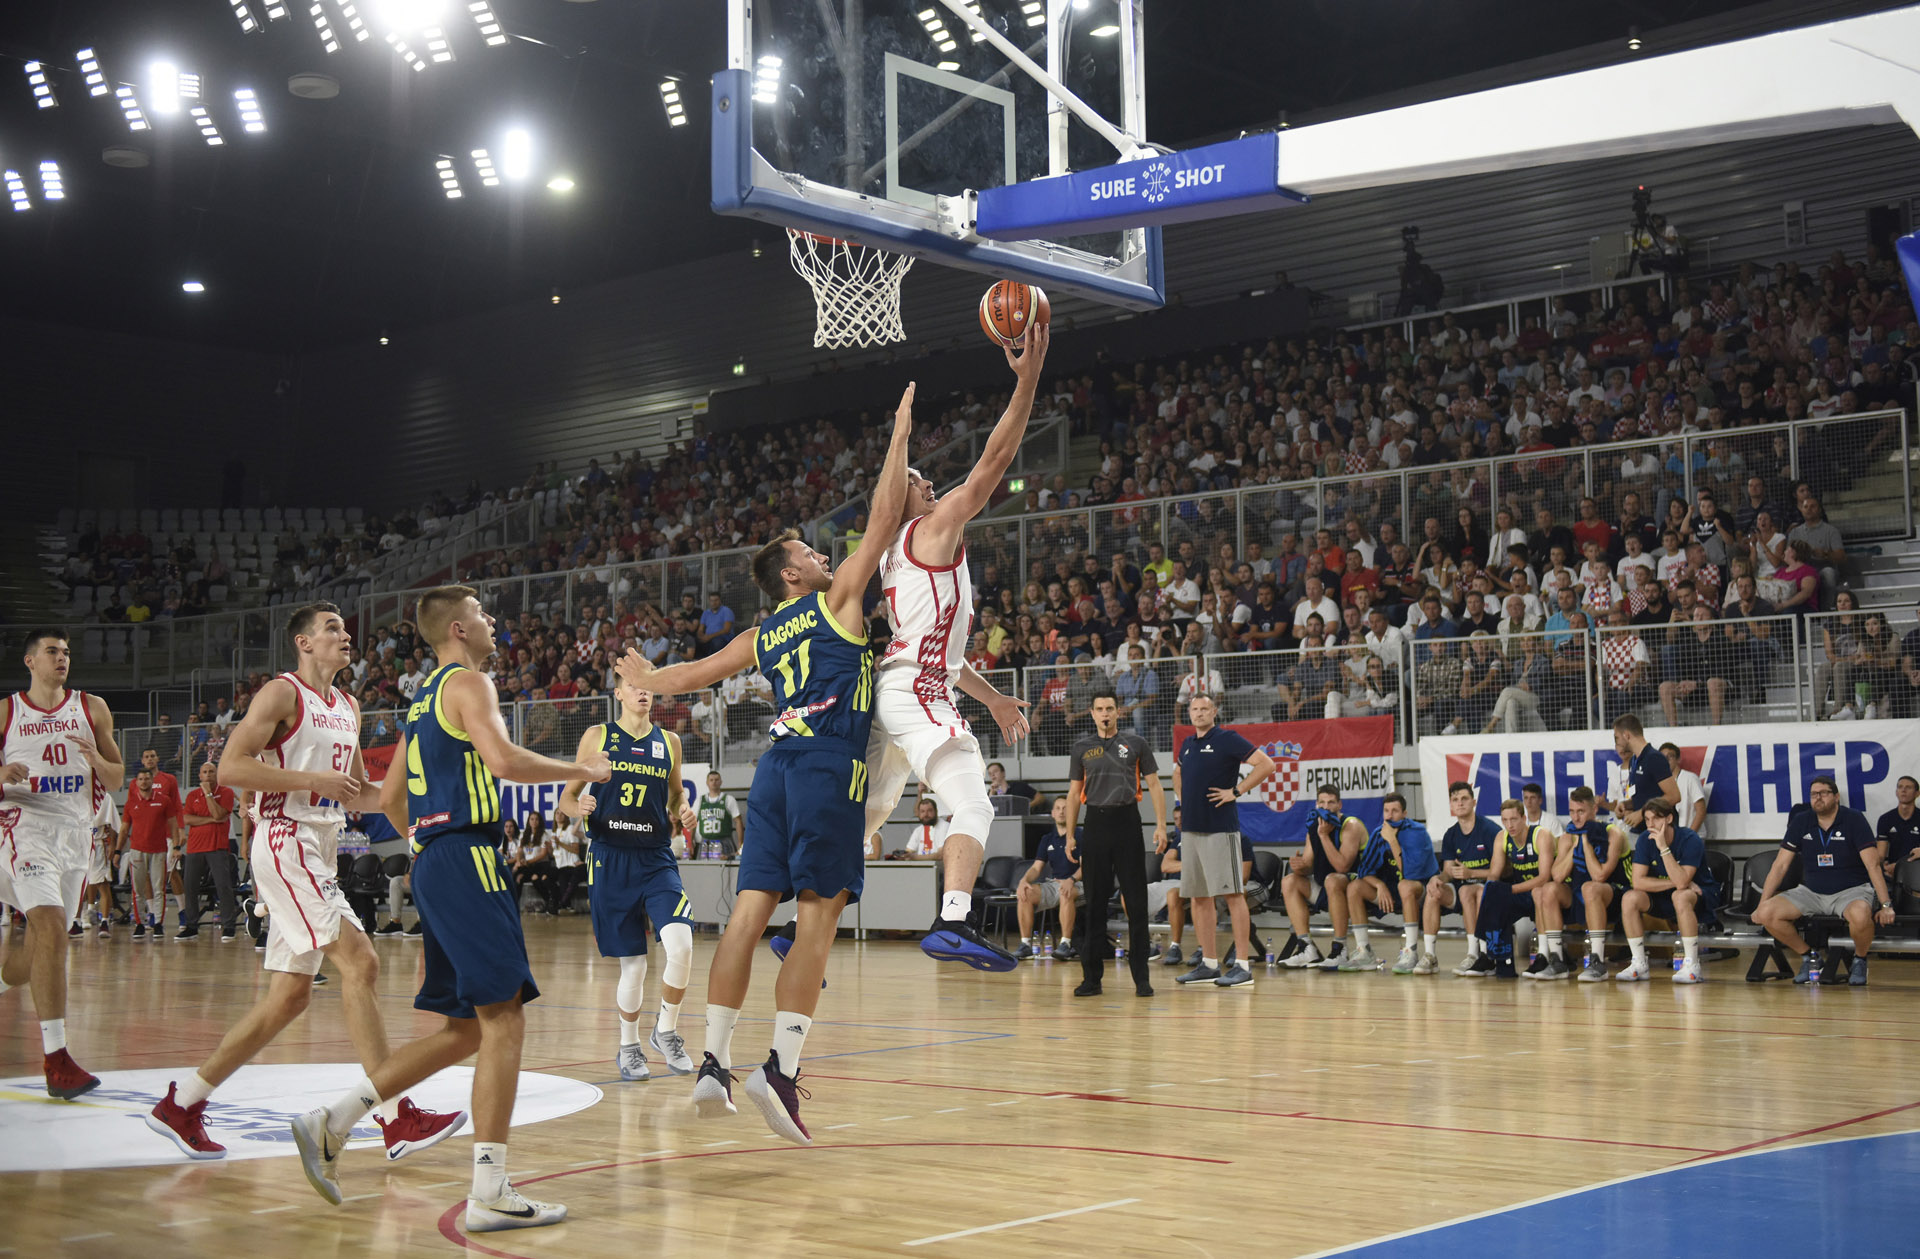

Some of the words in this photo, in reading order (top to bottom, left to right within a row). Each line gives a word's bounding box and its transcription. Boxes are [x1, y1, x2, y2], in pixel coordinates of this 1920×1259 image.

[1090, 177, 1136, 201] SURE
[1174, 164, 1226, 189] SHOT
[1142, 162, 1172, 180] SURE
[1141, 185, 1171, 203] SHOT
[992, 283, 1004, 322] molten
[761, 609, 818, 653] ZAGORAC
[772, 638, 812, 699] 17
[19, 719, 79, 737] HRVATSKA
[42, 743, 68, 766] 40
[332, 743, 353, 774] 27
[1306, 764, 1387, 793] PETRIJANEC
[620, 782, 647, 808] 37
[608, 820, 653, 833] telemach
[703, 820, 721, 834] 20
